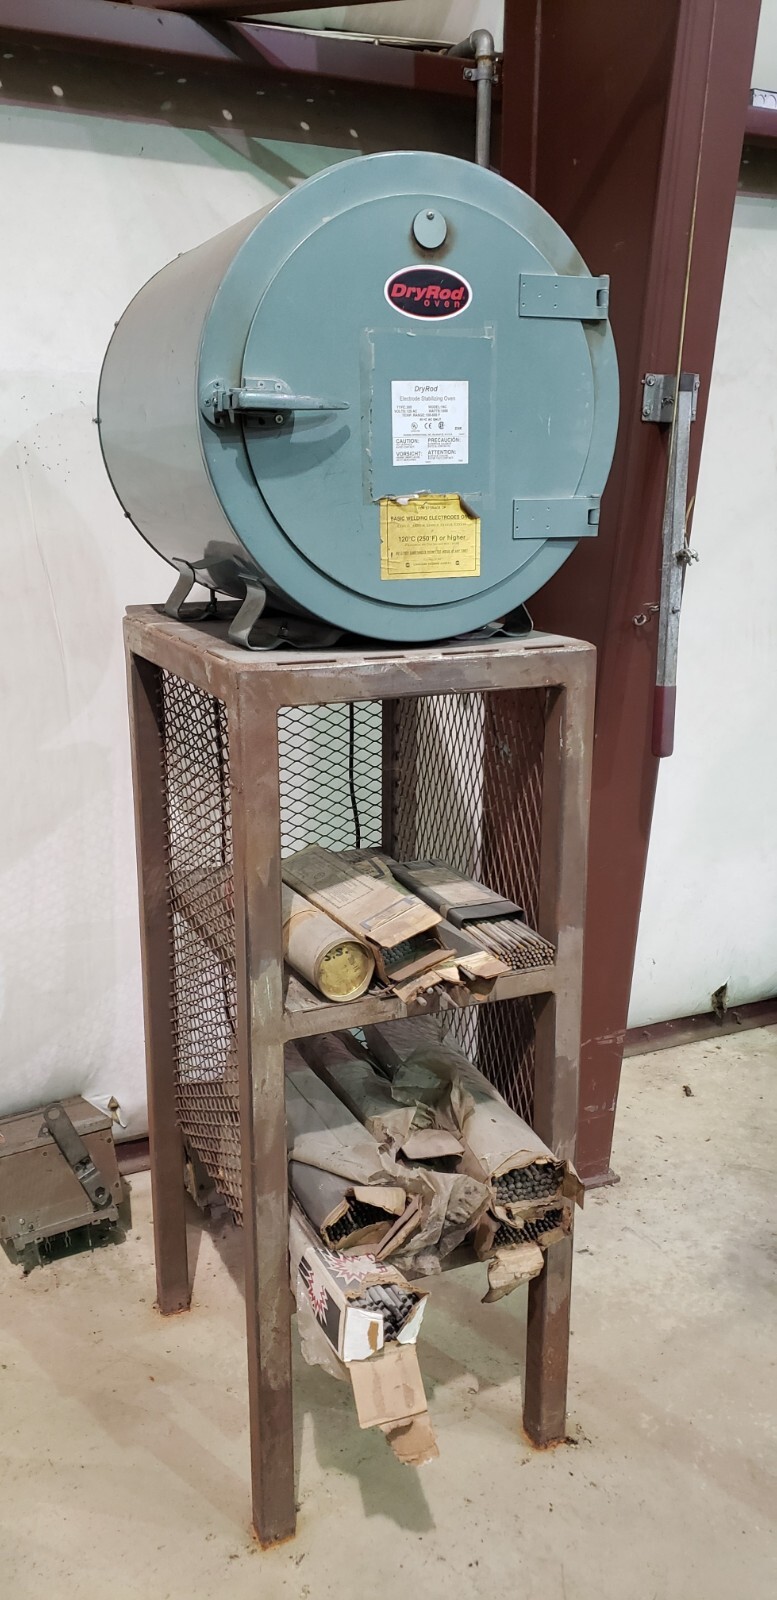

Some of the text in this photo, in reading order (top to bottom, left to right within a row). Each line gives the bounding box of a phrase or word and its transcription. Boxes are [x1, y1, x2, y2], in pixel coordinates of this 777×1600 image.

[391, 283, 465, 301] DryRod
[423, 299, 460, 308] oven
[414, 385, 438, 393] DryRod
[446, 534, 466, 542] higher
